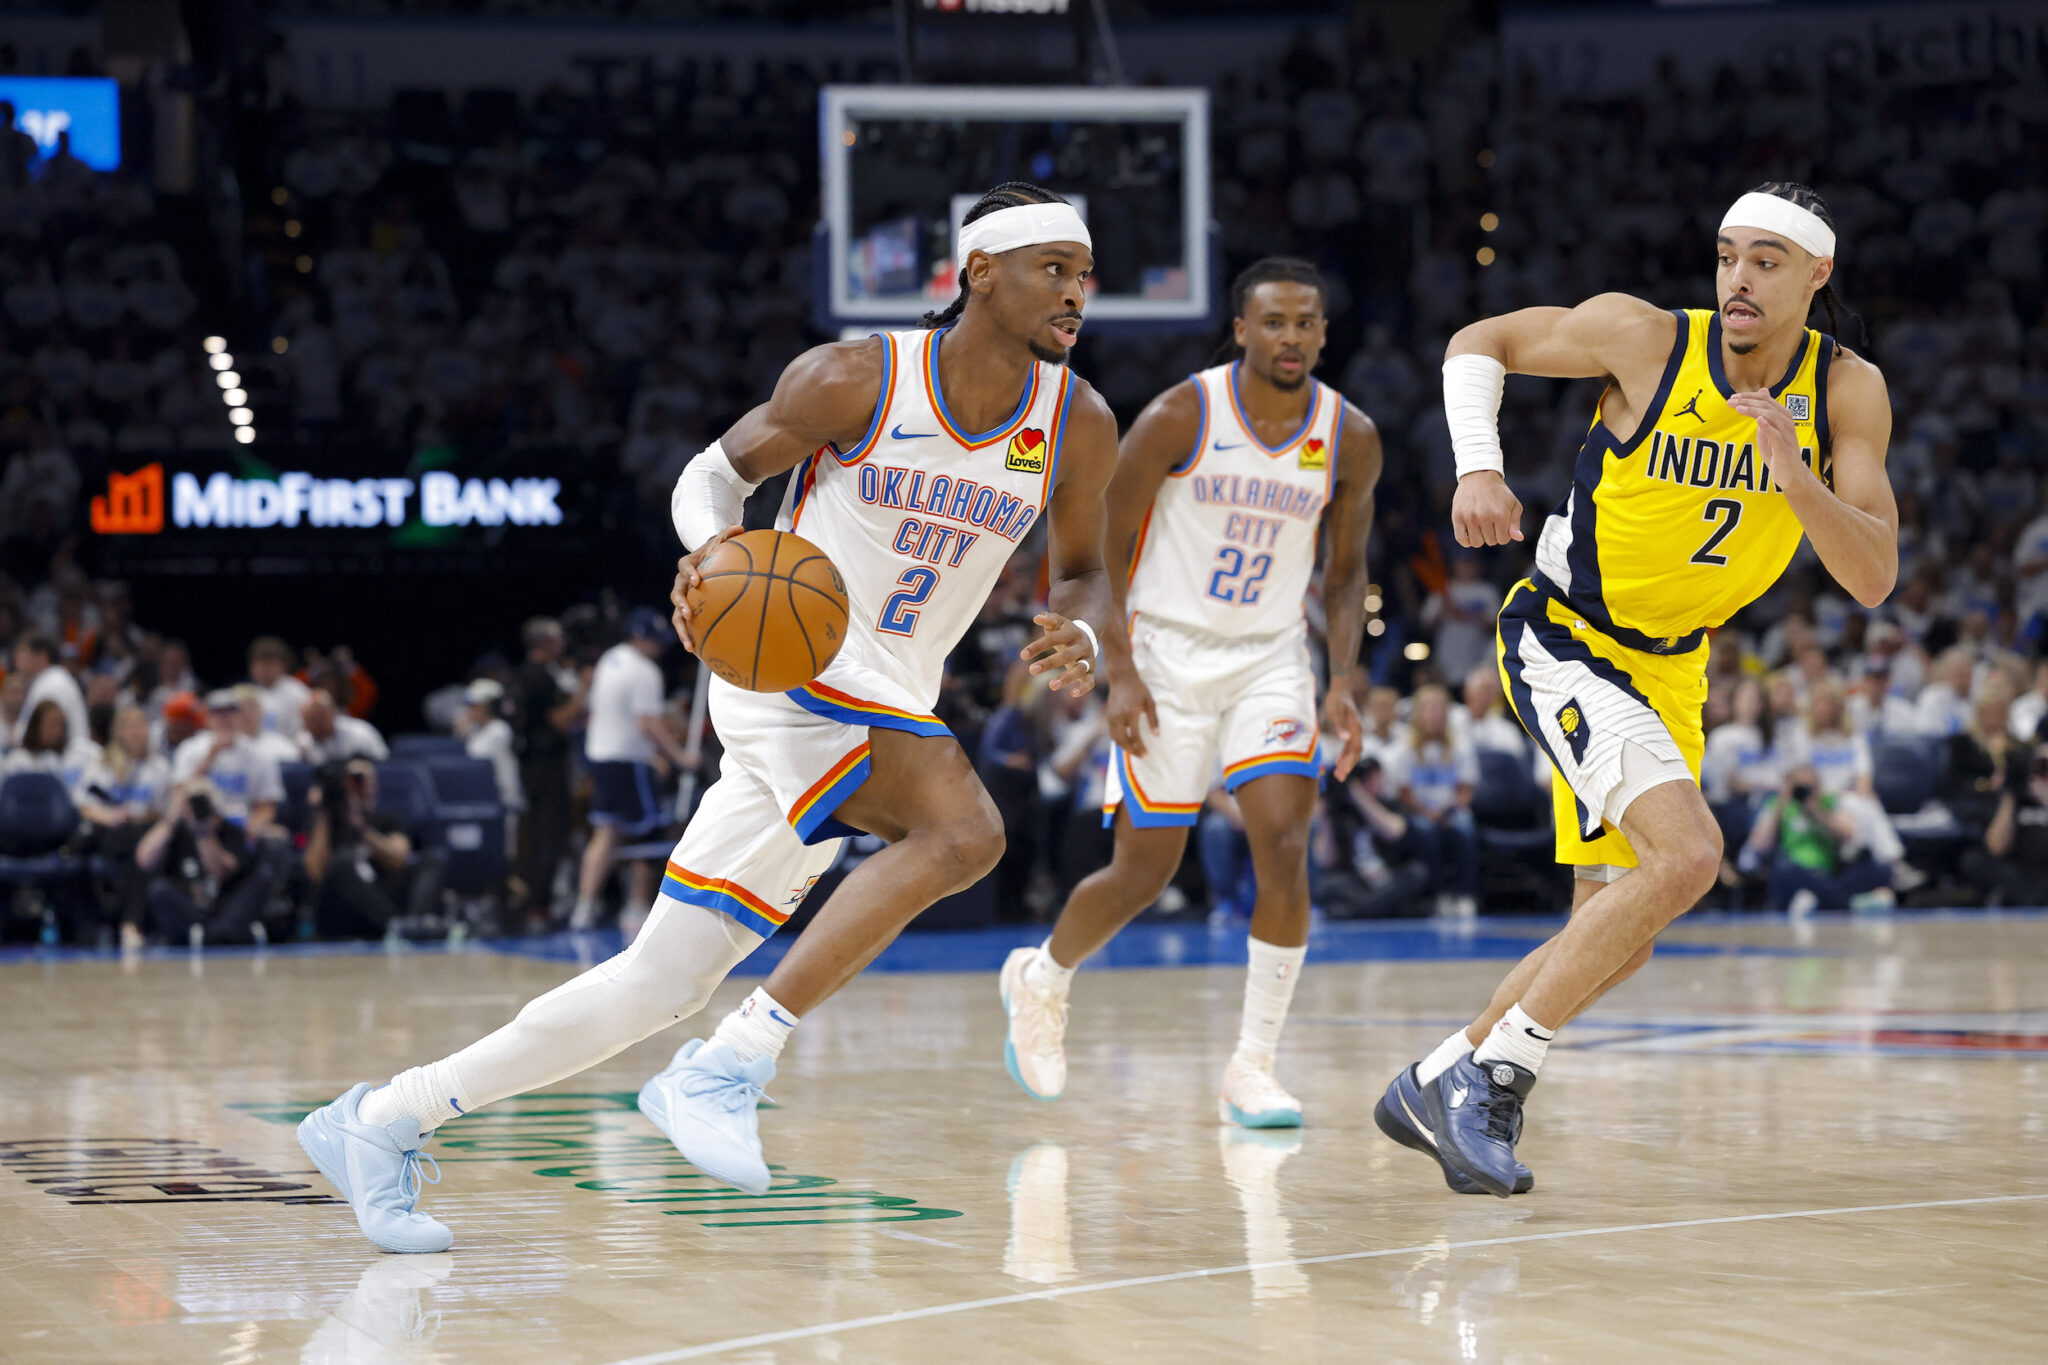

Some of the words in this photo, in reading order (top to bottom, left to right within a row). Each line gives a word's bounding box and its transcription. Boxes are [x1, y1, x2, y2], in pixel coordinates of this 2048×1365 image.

[859, 463, 1037, 543] OKLAHOMA
[1192, 474, 1325, 522] OKLAHOMA
[892, 518, 980, 568] CITY
[1223, 512, 1287, 551] CITY
[1689, 497, 1744, 567] 2
[876, 565, 941, 638] 2
[1204, 544, 1276, 608] 22
